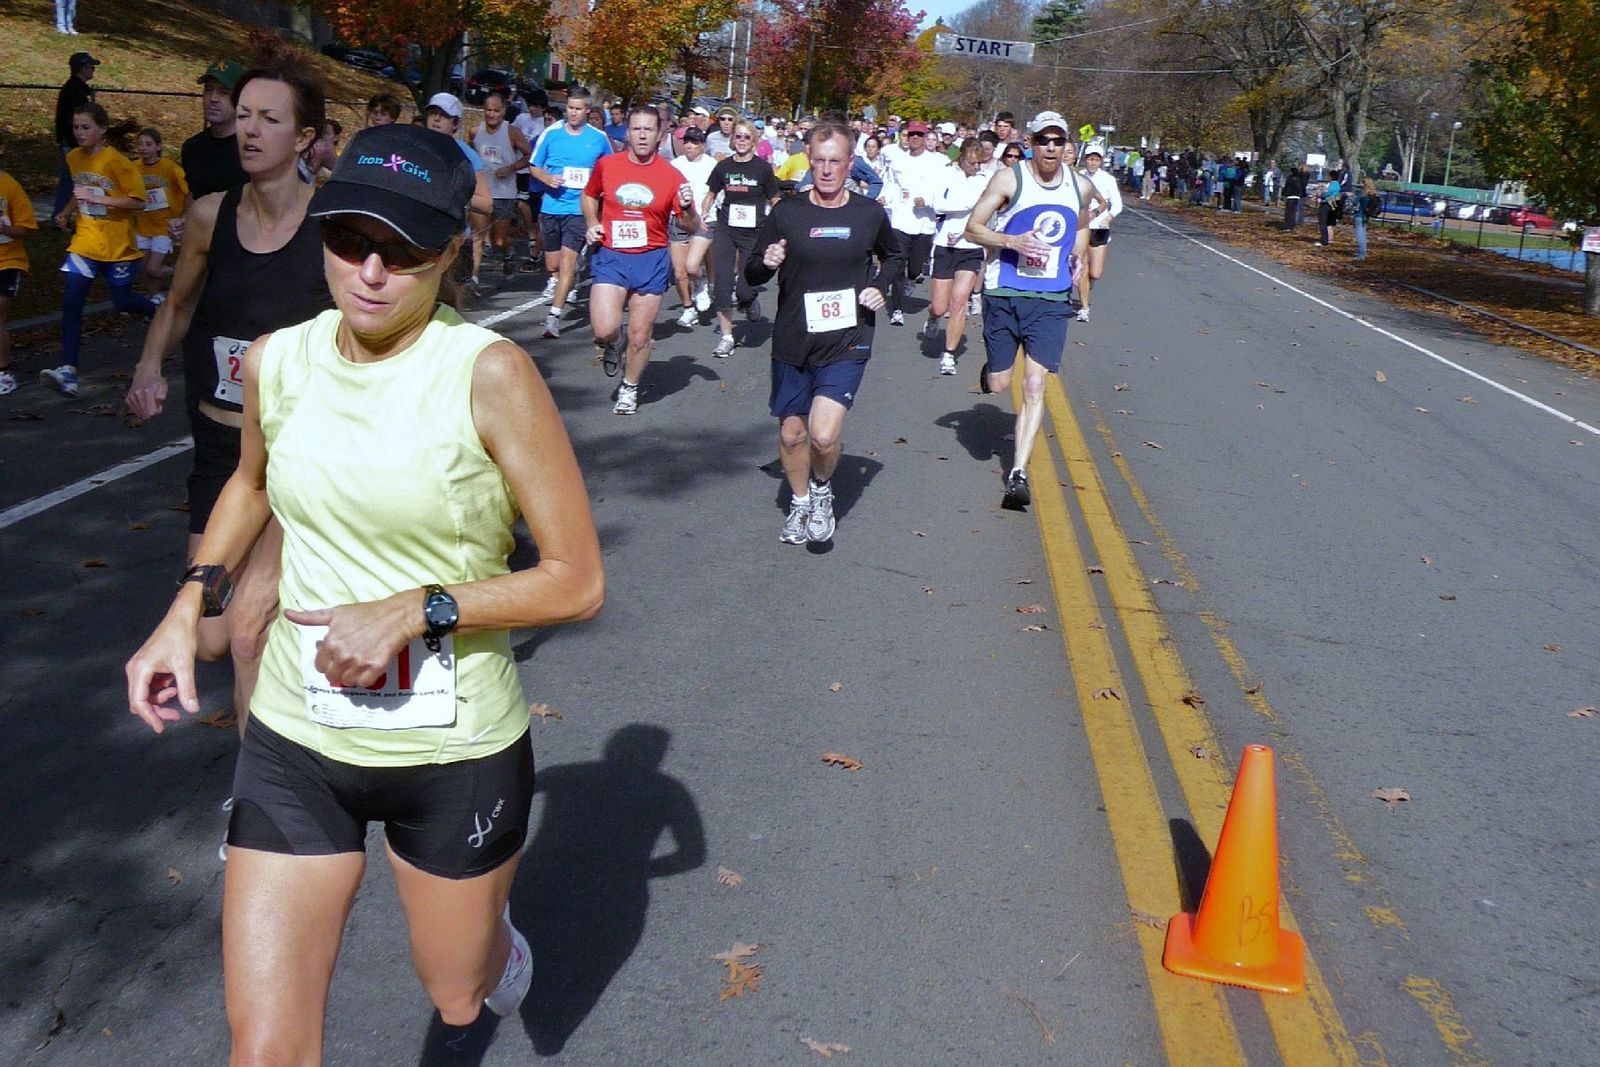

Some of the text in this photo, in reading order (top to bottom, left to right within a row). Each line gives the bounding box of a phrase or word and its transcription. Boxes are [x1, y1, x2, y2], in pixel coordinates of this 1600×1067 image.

[956, 38, 1014, 57] START
[357, 155, 429, 180] Iron Girl
[618, 228, 639, 240] 445
[821, 302, 841, 318] 63
